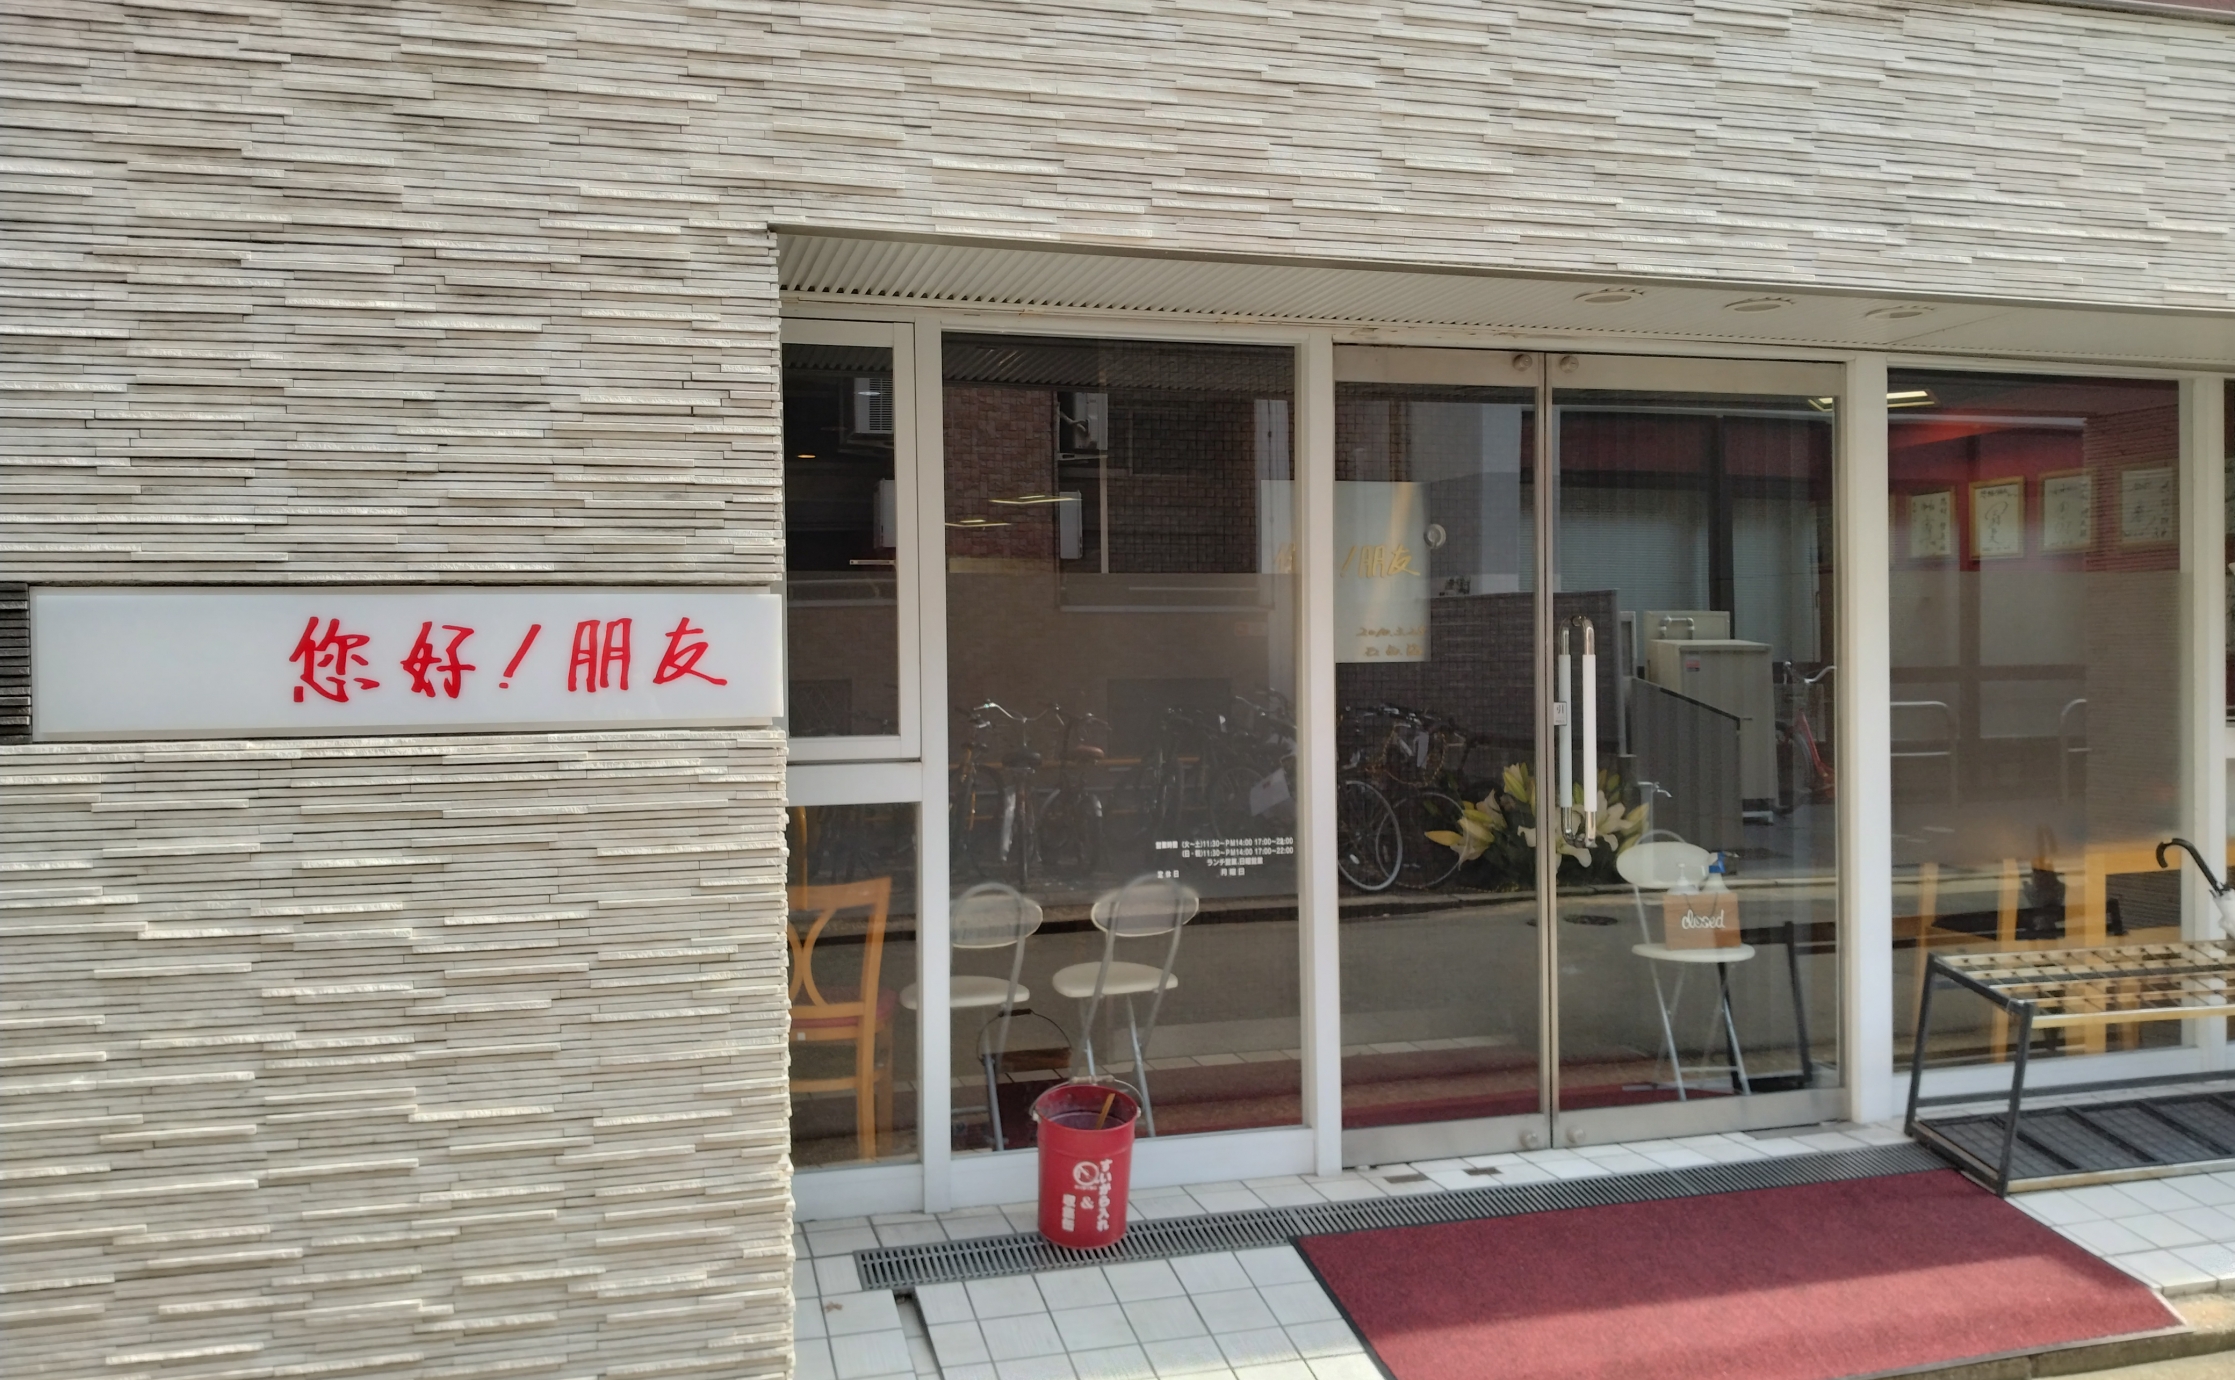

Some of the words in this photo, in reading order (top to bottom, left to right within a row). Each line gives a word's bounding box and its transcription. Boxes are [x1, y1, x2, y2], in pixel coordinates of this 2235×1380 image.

[290, 616, 727, 702] 您好！朋友
[1681, 909, 1726, 930] closed
[1080, 1196, 1095, 1210] &
